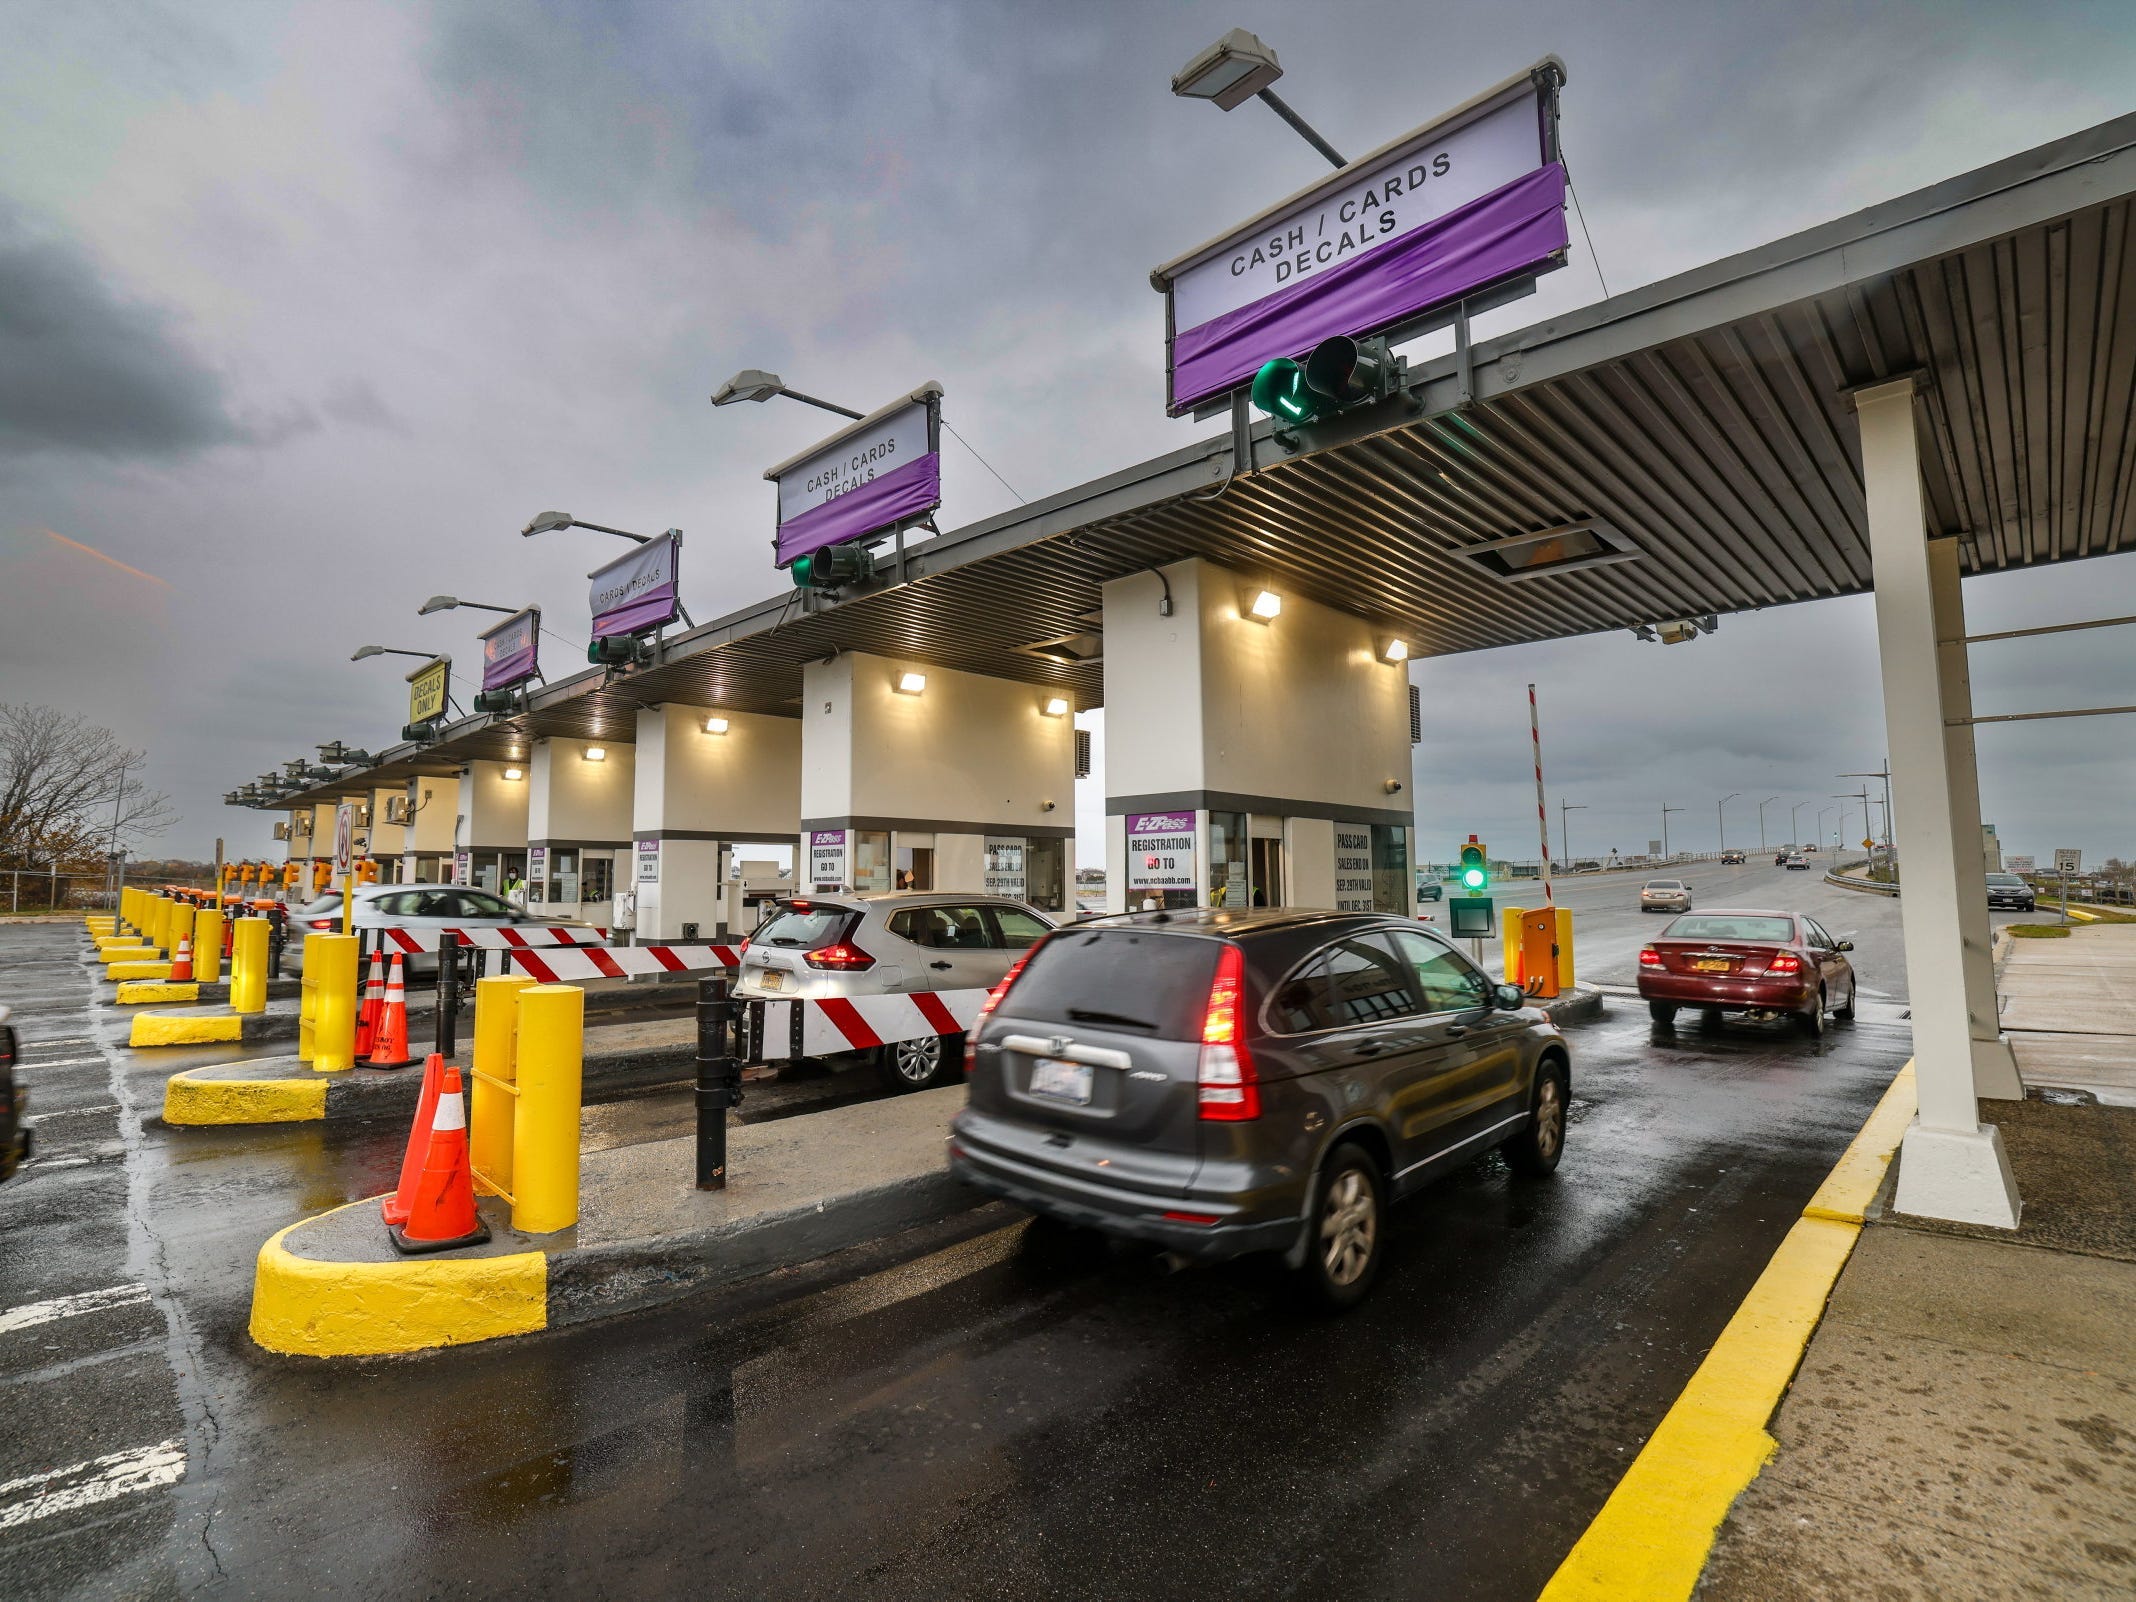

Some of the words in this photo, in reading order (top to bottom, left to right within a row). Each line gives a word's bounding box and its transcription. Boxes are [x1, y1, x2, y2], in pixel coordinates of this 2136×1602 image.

[1231, 225, 1303, 277] CASH
[1338, 151, 1452, 225] CARDS
[1275, 209, 1397, 284] DECALS
[807, 466, 838, 493] CASH
[851, 438, 896, 471] CARDS
[825, 467, 875, 502] DECALS
[599, 585, 624, 604] CARDS
[631, 568, 660, 591] DECALS
[413, 674, 441, 701] DECALS
[417, 693, 436, 715] ONLY
[1132, 837, 1191, 852] REGISTRATION
[1337, 833, 1352, 849] PASS
[1353, 834, 1368, 850] CARD
[813, 848, 843, 858] REGISTRATION
[989, 844, 1005, 856] PASS
[1005, 844, 1022, 856] CARD
[820, 862, 828, 872] GO
[829, 862, 835, 871] TO
[1147, 857, 1160, 870] GO
[1163, 857, 1175, 870] TO
[1337, 857, 1352, 871] SALES
[1353, 858, 1362, 871] END
[2059, 862, 2075, 871] 15
[985, 878, 996, 887] SEP.
[996, 878, 1010, 888] 29TH
[1010, 878, 1025, 888] VALID
[1336, 878, 1346, 892] SEP.
[1346, 879, 1358, 892] 29TH
[1359, 878, 1371, 891] VALID
